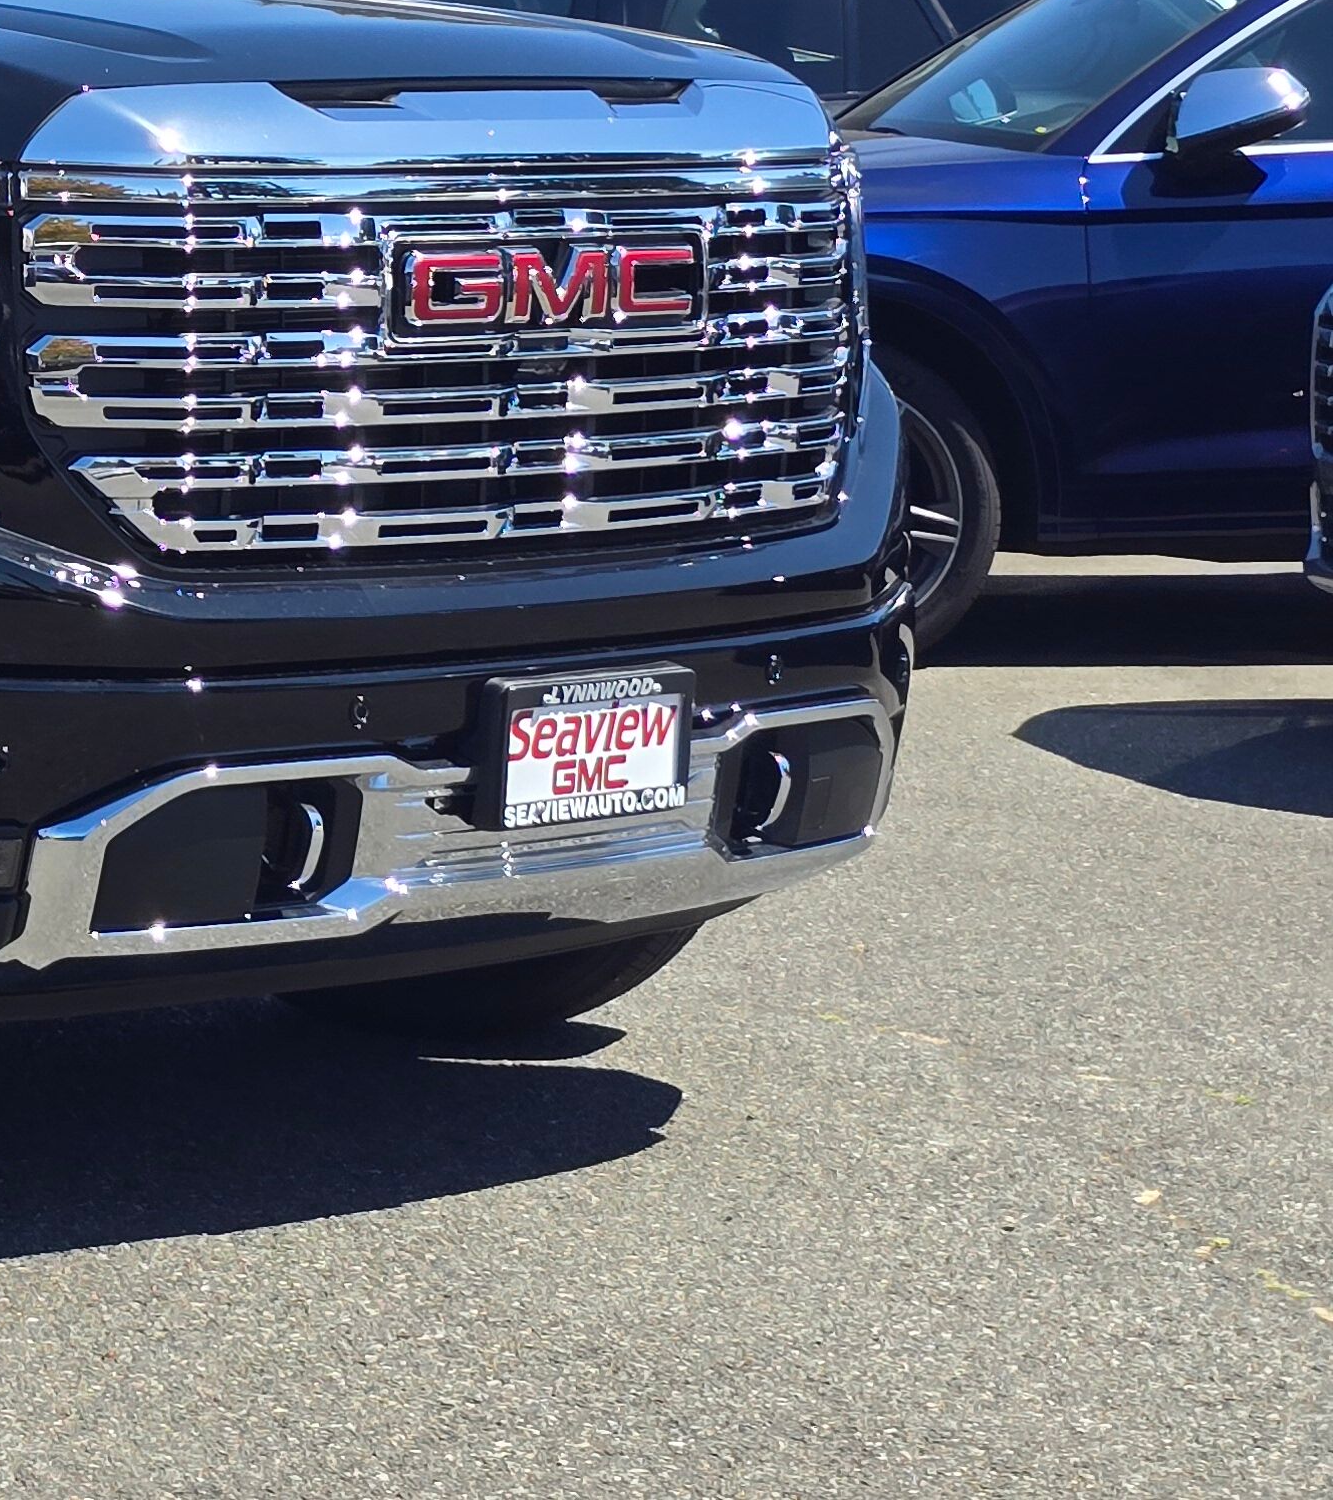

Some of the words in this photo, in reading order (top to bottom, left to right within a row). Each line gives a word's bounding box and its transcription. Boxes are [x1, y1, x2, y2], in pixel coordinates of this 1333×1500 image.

[404, 243, 694, 325] GMC
[548, 676, 655, 705] LYNNWOOD
[507, 702, 678, 762] Seaview
[551, 754, 629, 796] GMC
[503, 784, 685, 829] SEAVIEWAUTO.COM
